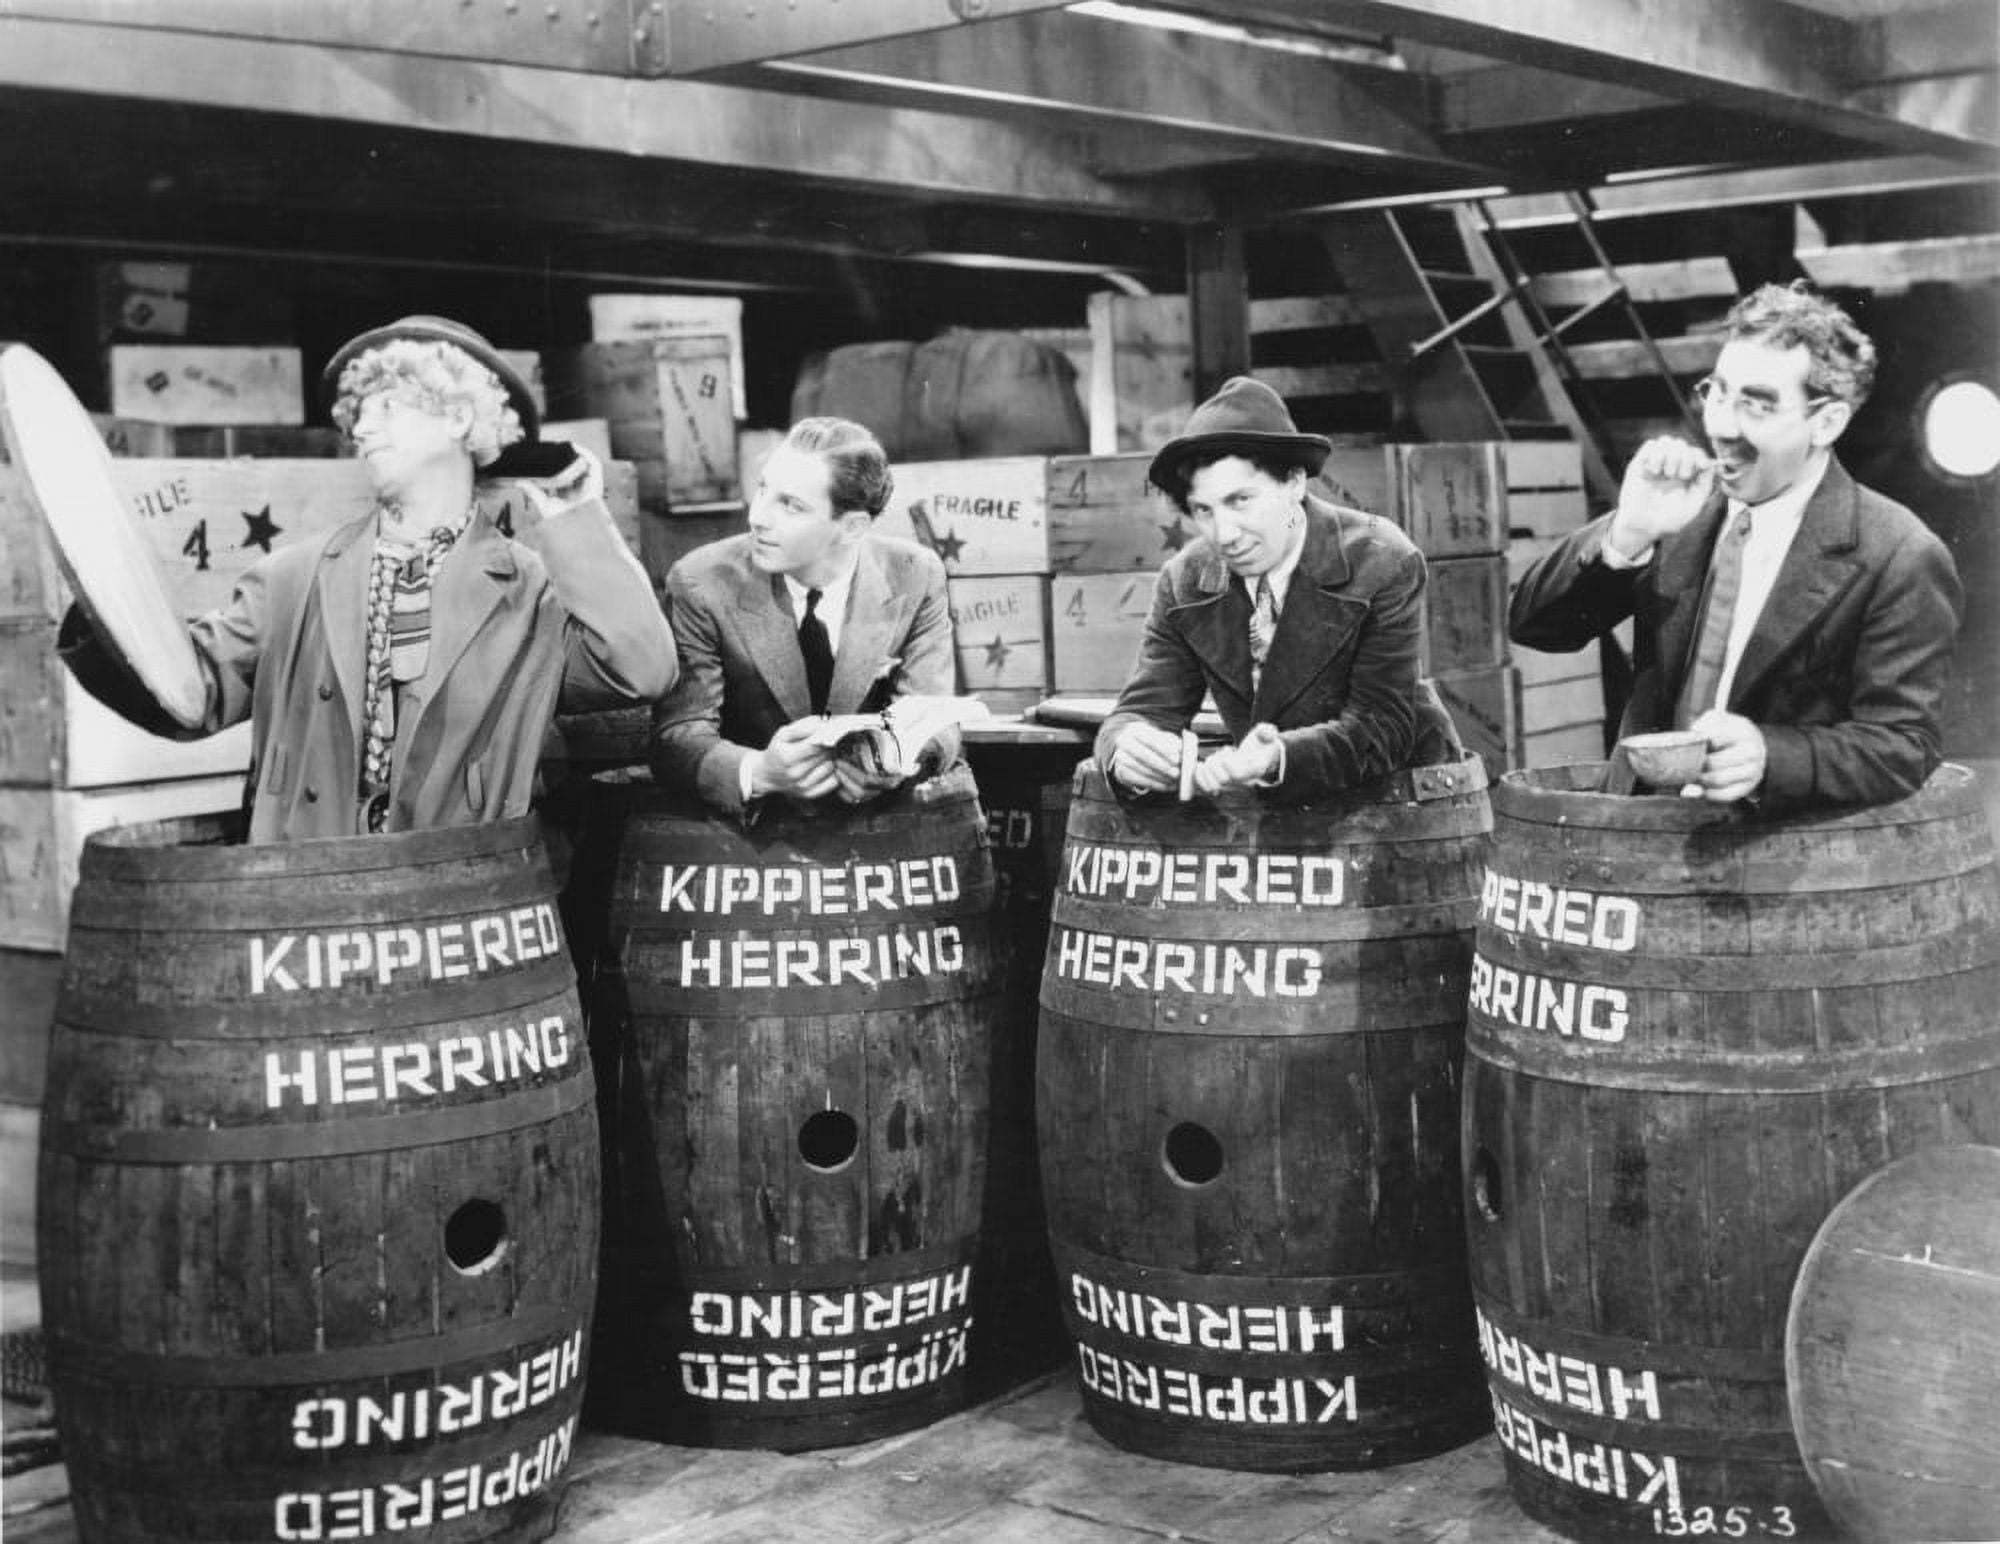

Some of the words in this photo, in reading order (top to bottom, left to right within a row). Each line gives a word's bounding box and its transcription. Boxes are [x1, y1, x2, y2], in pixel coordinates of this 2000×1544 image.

[932, 494, 1020, 520] FRAGILE
[1069, 468, 1088, 506] 4
[182, 518, 211, 571] 4
[1066, 587, 1087, 626] 4
[660, 856, 960, 915] KIPPERED
[1068, 845, 1345, 906] KIPPERED
[249, 904, 559, 994] KIPPERED
[681, 926, 963, 989] HERRING
[1058, 930, 1322, 998] HERRING
[265, 1015, 568, 1108] HERRING
[690, 1265, 971, 1338] HERRING
[1072, 1274, 1345, 1351] HERRING
[291, 1330, 581, 1448] HERRING
[678, 1317, 974, 1401] KIPPERED
[1079, 1341, 1357, 1424] KIPPERED
[275, 1416, 576, 1541] KIPPERED
